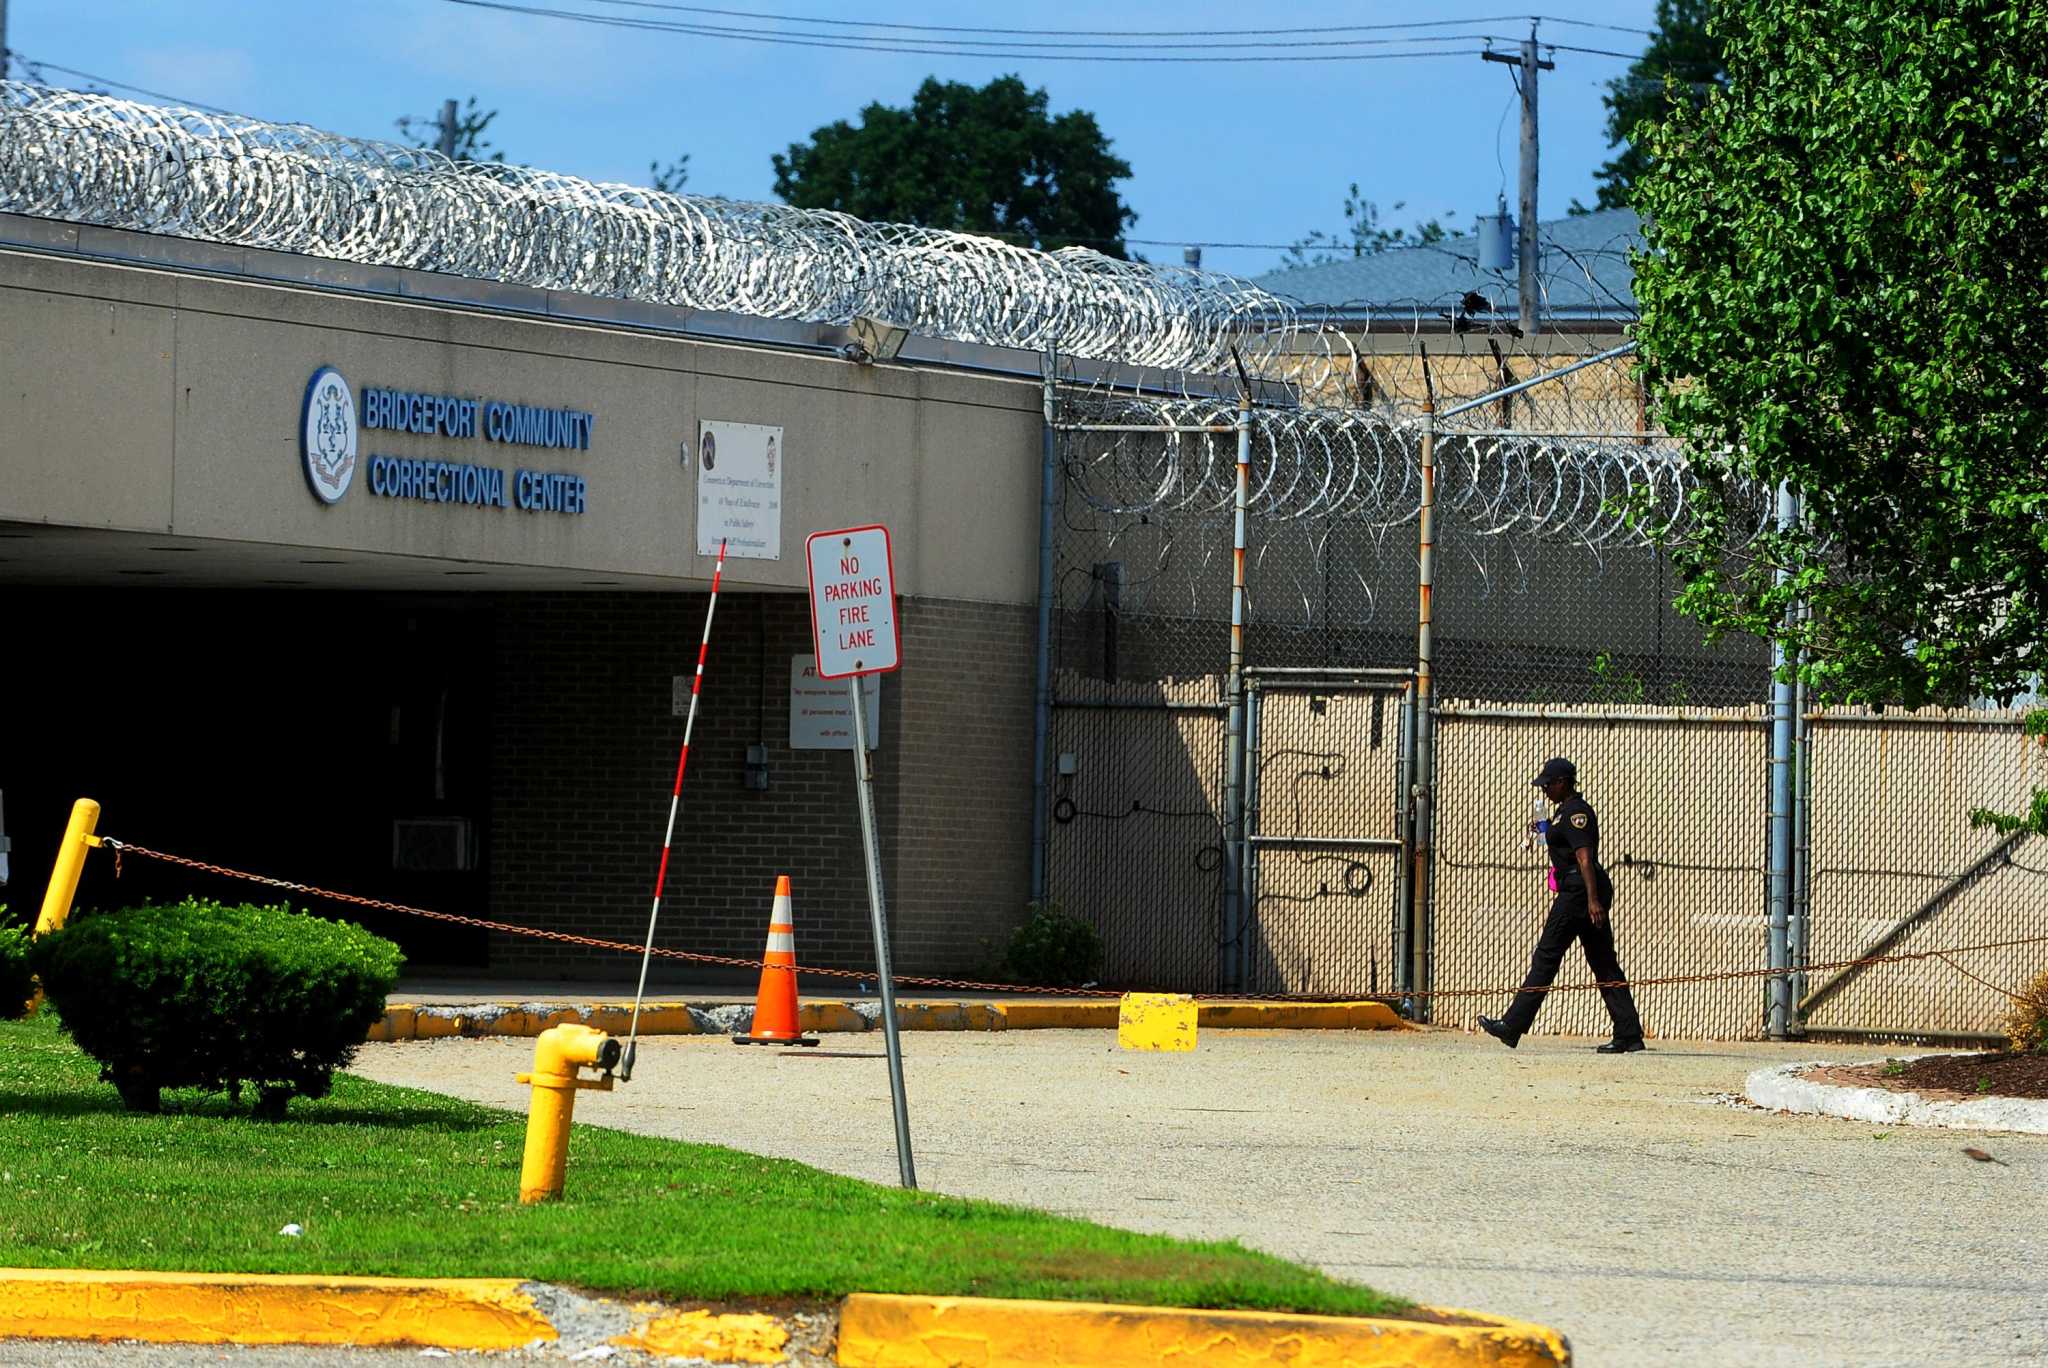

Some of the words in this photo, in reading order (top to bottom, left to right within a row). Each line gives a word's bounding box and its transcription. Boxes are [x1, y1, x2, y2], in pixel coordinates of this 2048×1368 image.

[361, 387, 480, 438] BRIDGEPORT
[485, 402, 594, 450] COMMUNITY
[368, 454, 512, 507] CORRECTIONAL
[515, 469, 588, 513] CENTER
[840, 557, 859, 576] NO
[825, 578, 882, 602] PARKING
[840, 605, 869, 625] FIRE
[839, 629, 875, 650] LANE
